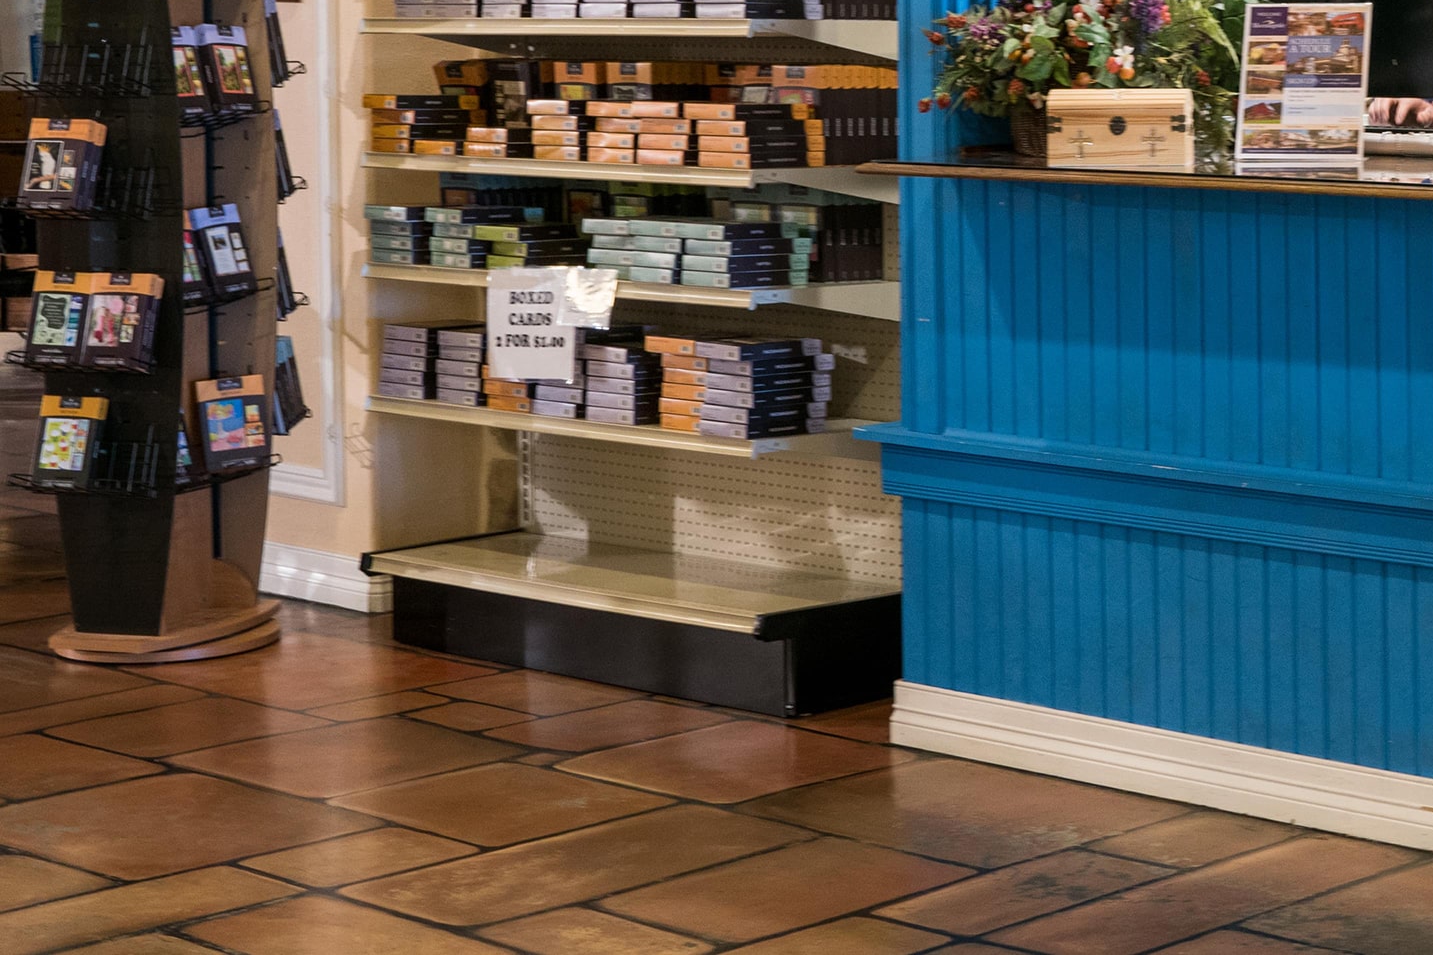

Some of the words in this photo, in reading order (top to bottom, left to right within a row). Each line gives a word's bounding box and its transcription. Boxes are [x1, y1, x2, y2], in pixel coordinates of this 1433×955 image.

[509, 291, 554, 304] BOXED
[508, 312, 552, 325] CARDS
[495, 336, 502, 347] 2
[505, 334, 531, 347] FOR
